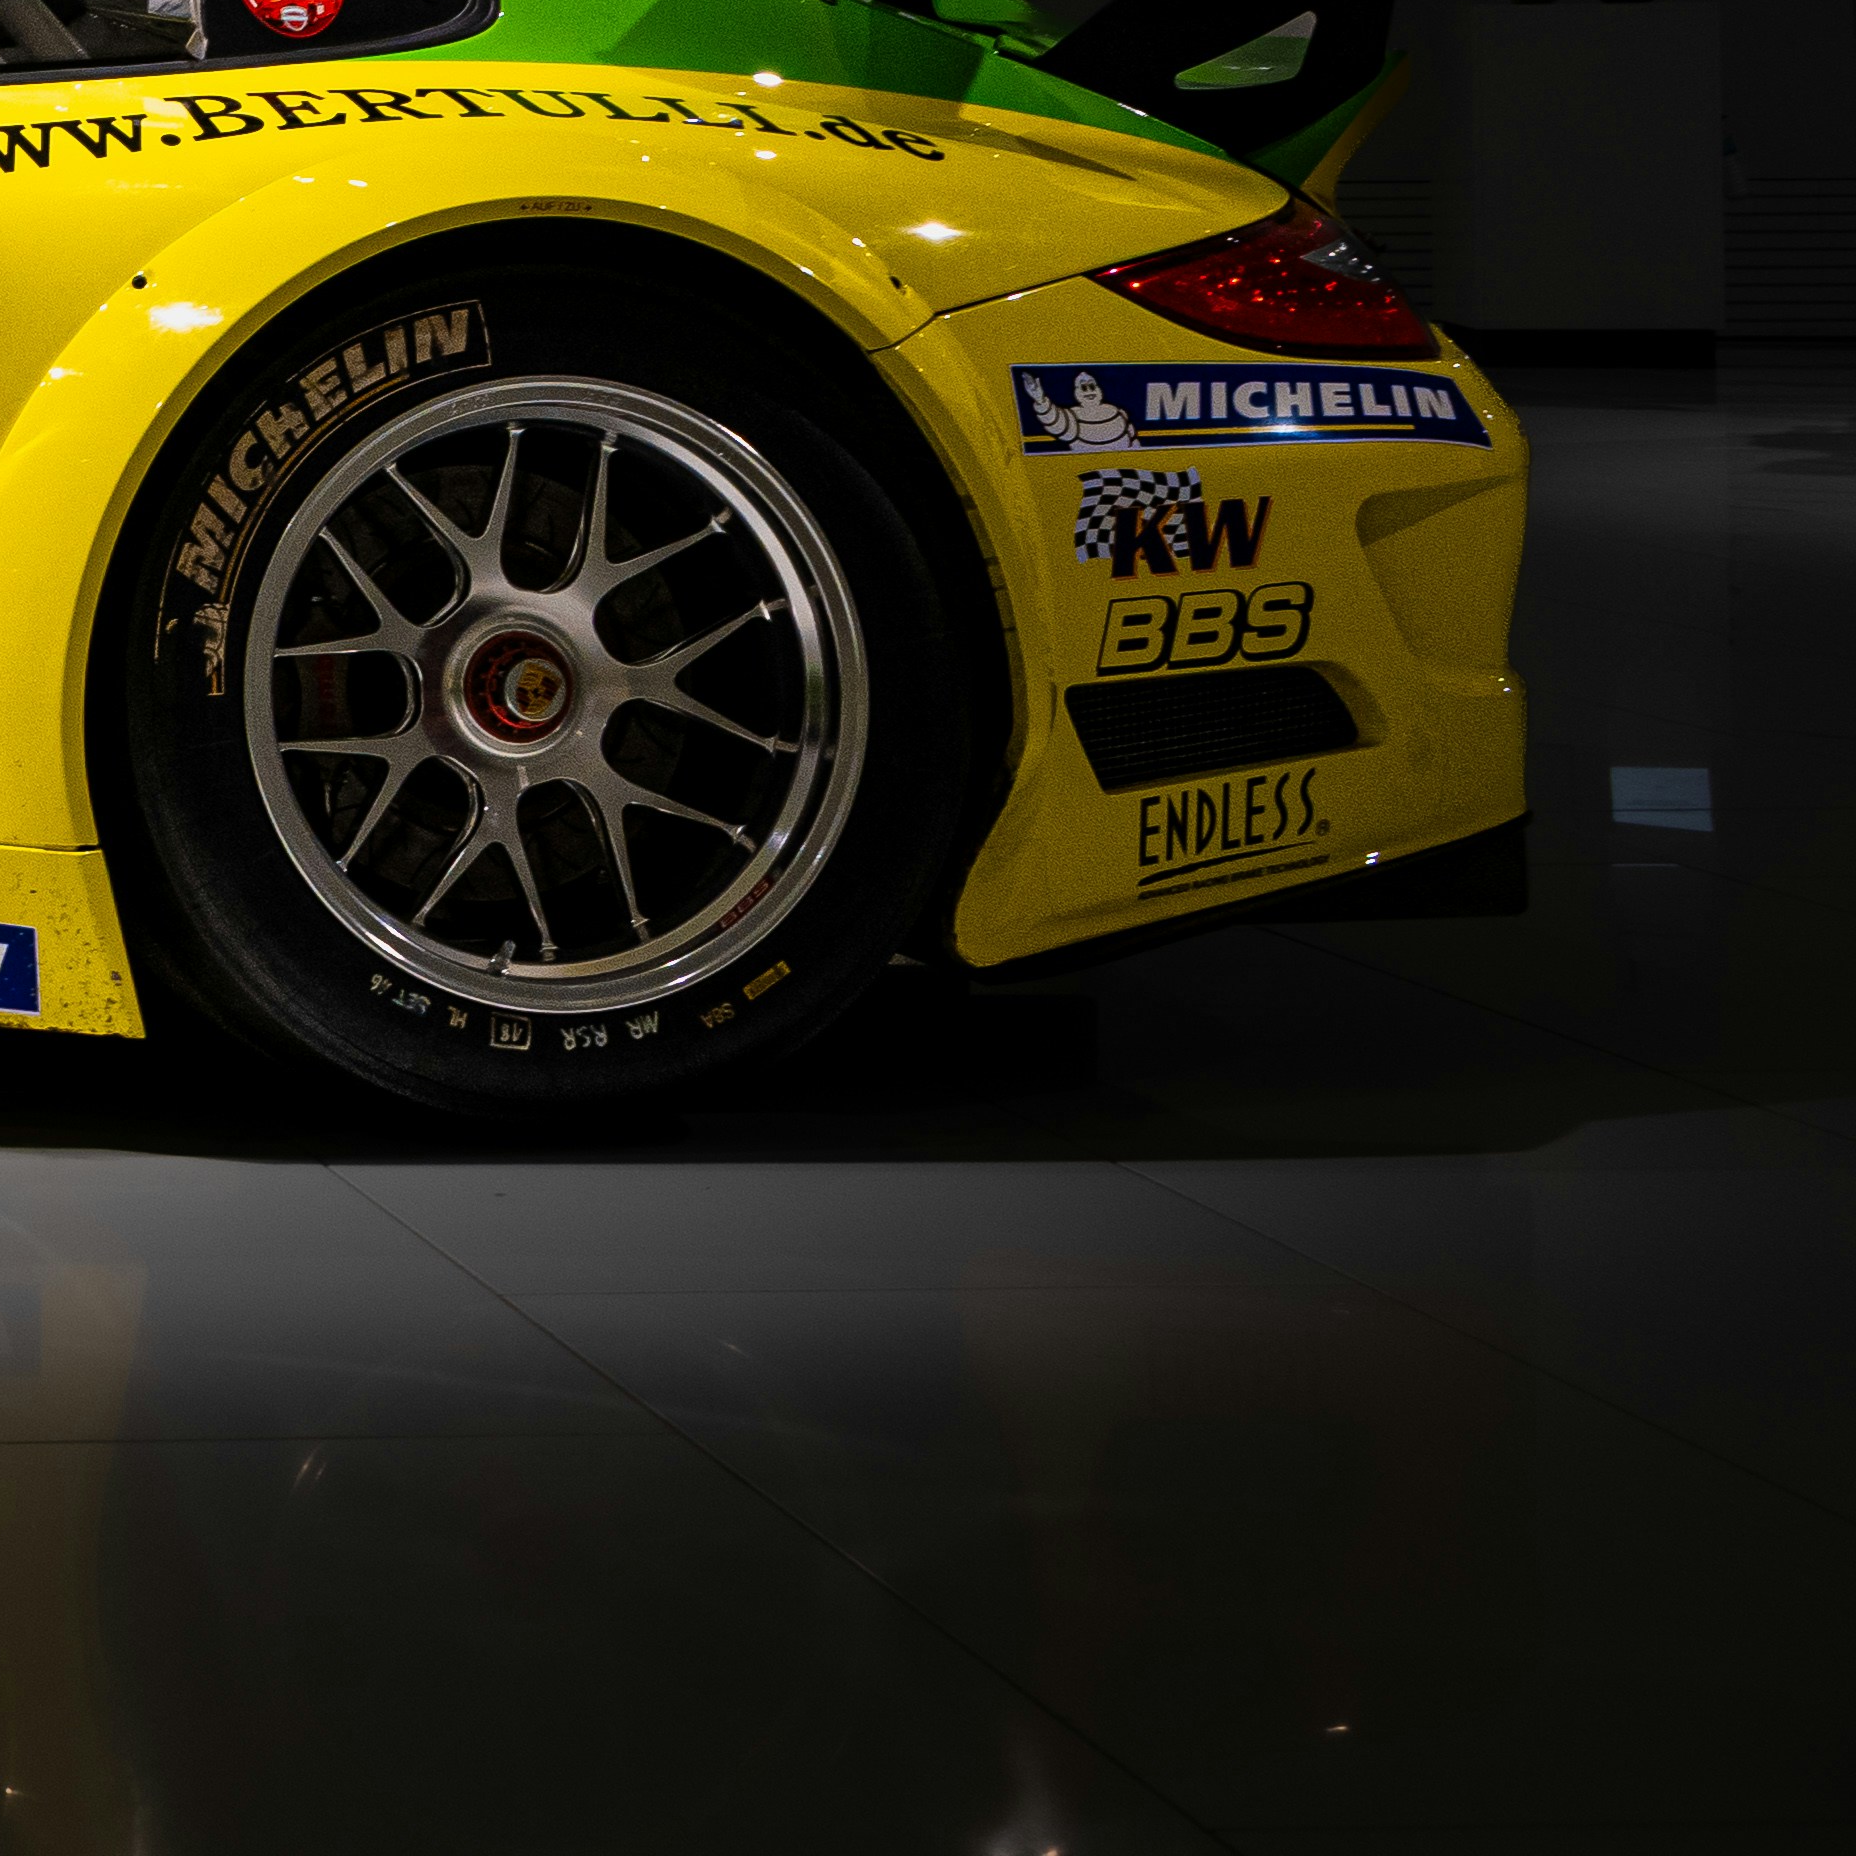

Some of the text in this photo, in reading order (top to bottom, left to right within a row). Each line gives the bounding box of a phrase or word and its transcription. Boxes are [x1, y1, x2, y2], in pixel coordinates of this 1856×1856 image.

[1146, 380, 1457, 420] MICHELIN
[177, 309, 470, 595] MICHELIN
[1111, 496, 1272, 578] KW
[1096, 581, 1315, 676] BBS
[1139, 767, 1316, 867] ENDLESS
[559, 1022, 609, 1052] RSR
